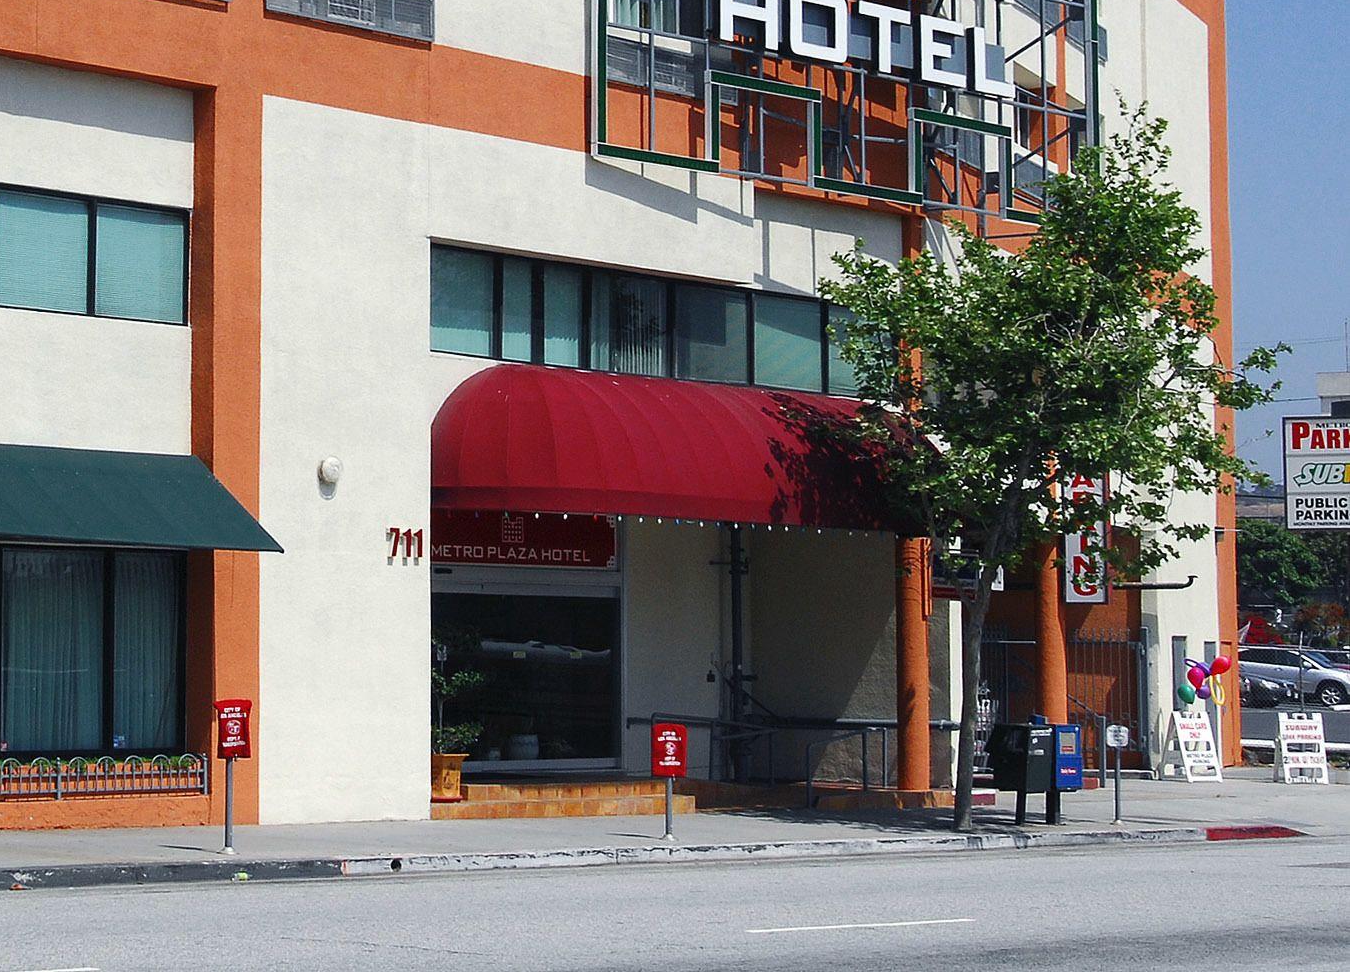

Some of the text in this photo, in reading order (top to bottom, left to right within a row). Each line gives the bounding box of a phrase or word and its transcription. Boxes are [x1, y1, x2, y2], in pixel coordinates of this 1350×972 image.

[1295, 497, 1348, 509] PUBLIC
[1295, 510, 1349, 521] PARKIN
[388, 527, 424, 558] 711
[430, 544, 591, 562] METRO PLAZA HOTEL
